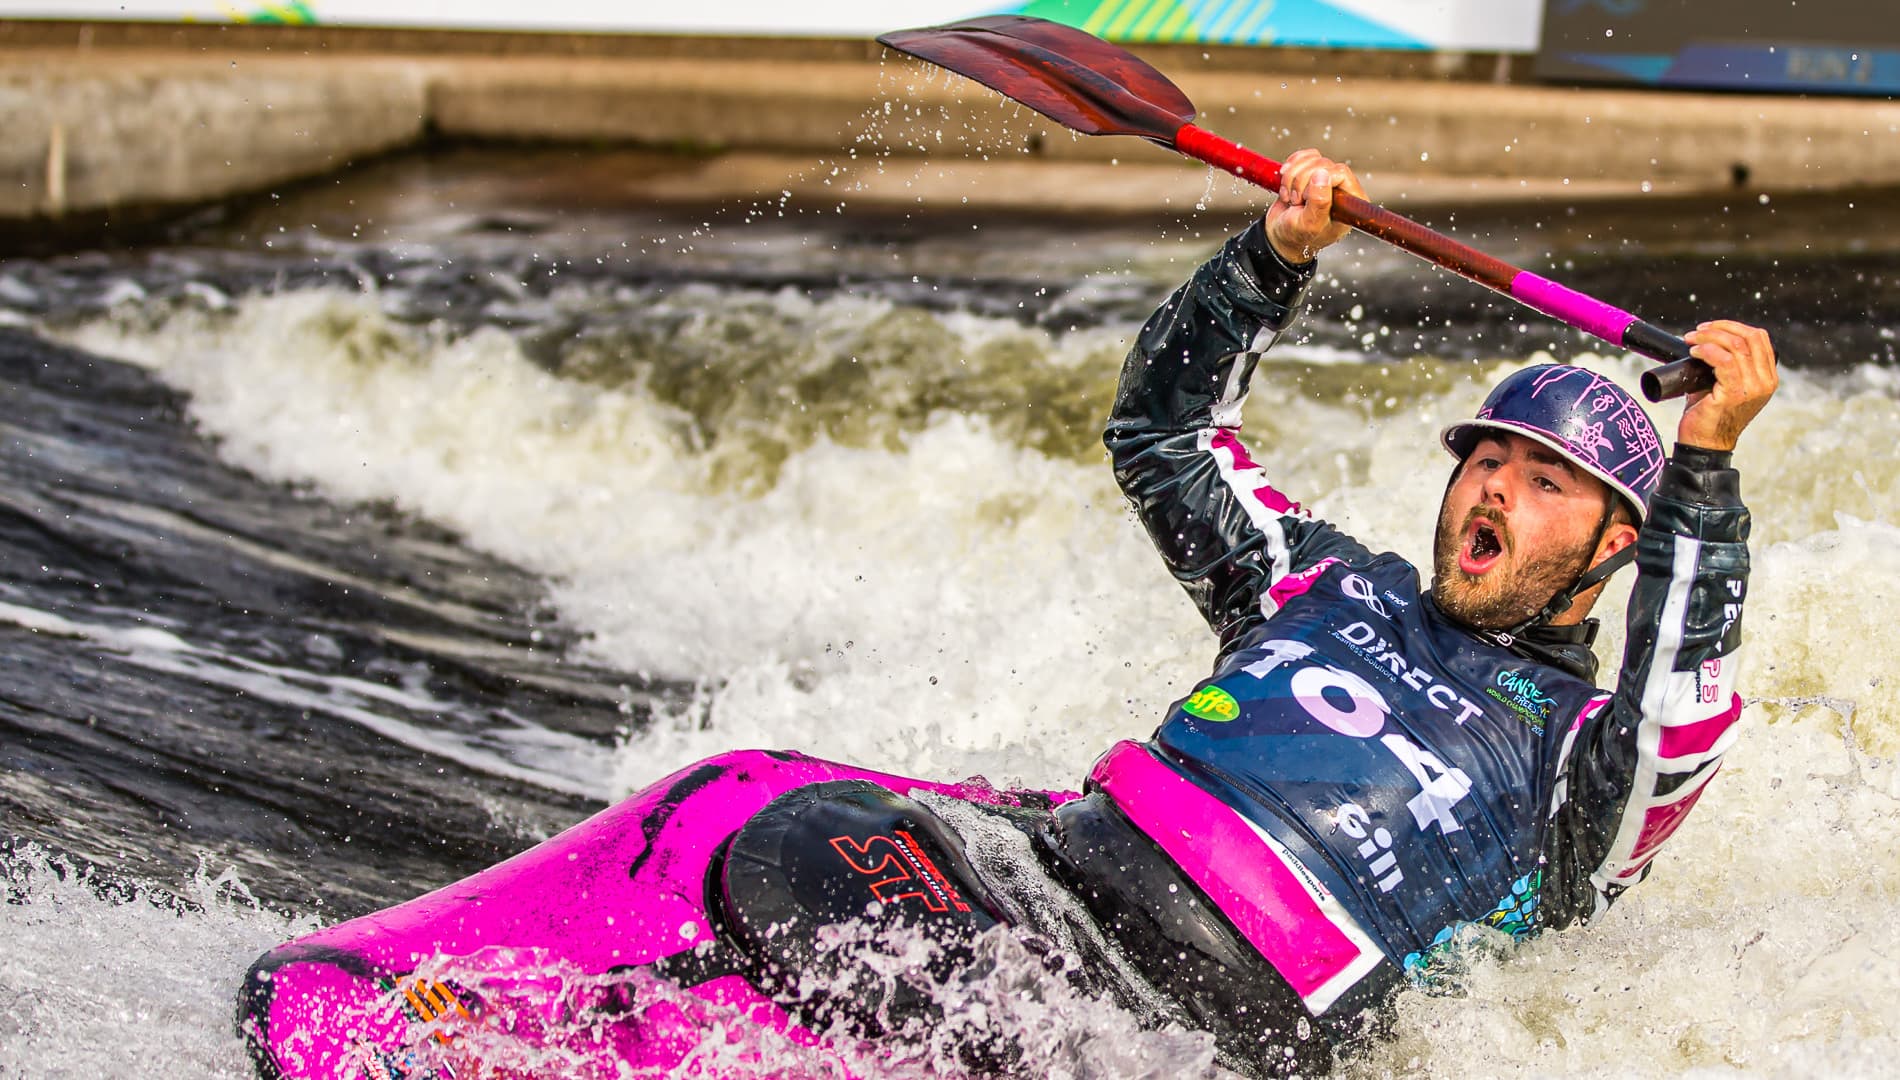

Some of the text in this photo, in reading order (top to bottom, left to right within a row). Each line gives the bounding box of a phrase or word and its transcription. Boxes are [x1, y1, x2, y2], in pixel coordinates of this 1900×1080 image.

[1364, 653, 1397, 683] Solutions
[1497, 671, 1550, 704] CANOE
[1241, 639, 1473, 835] 104
[1337, 803, 1404, 893] Gill
